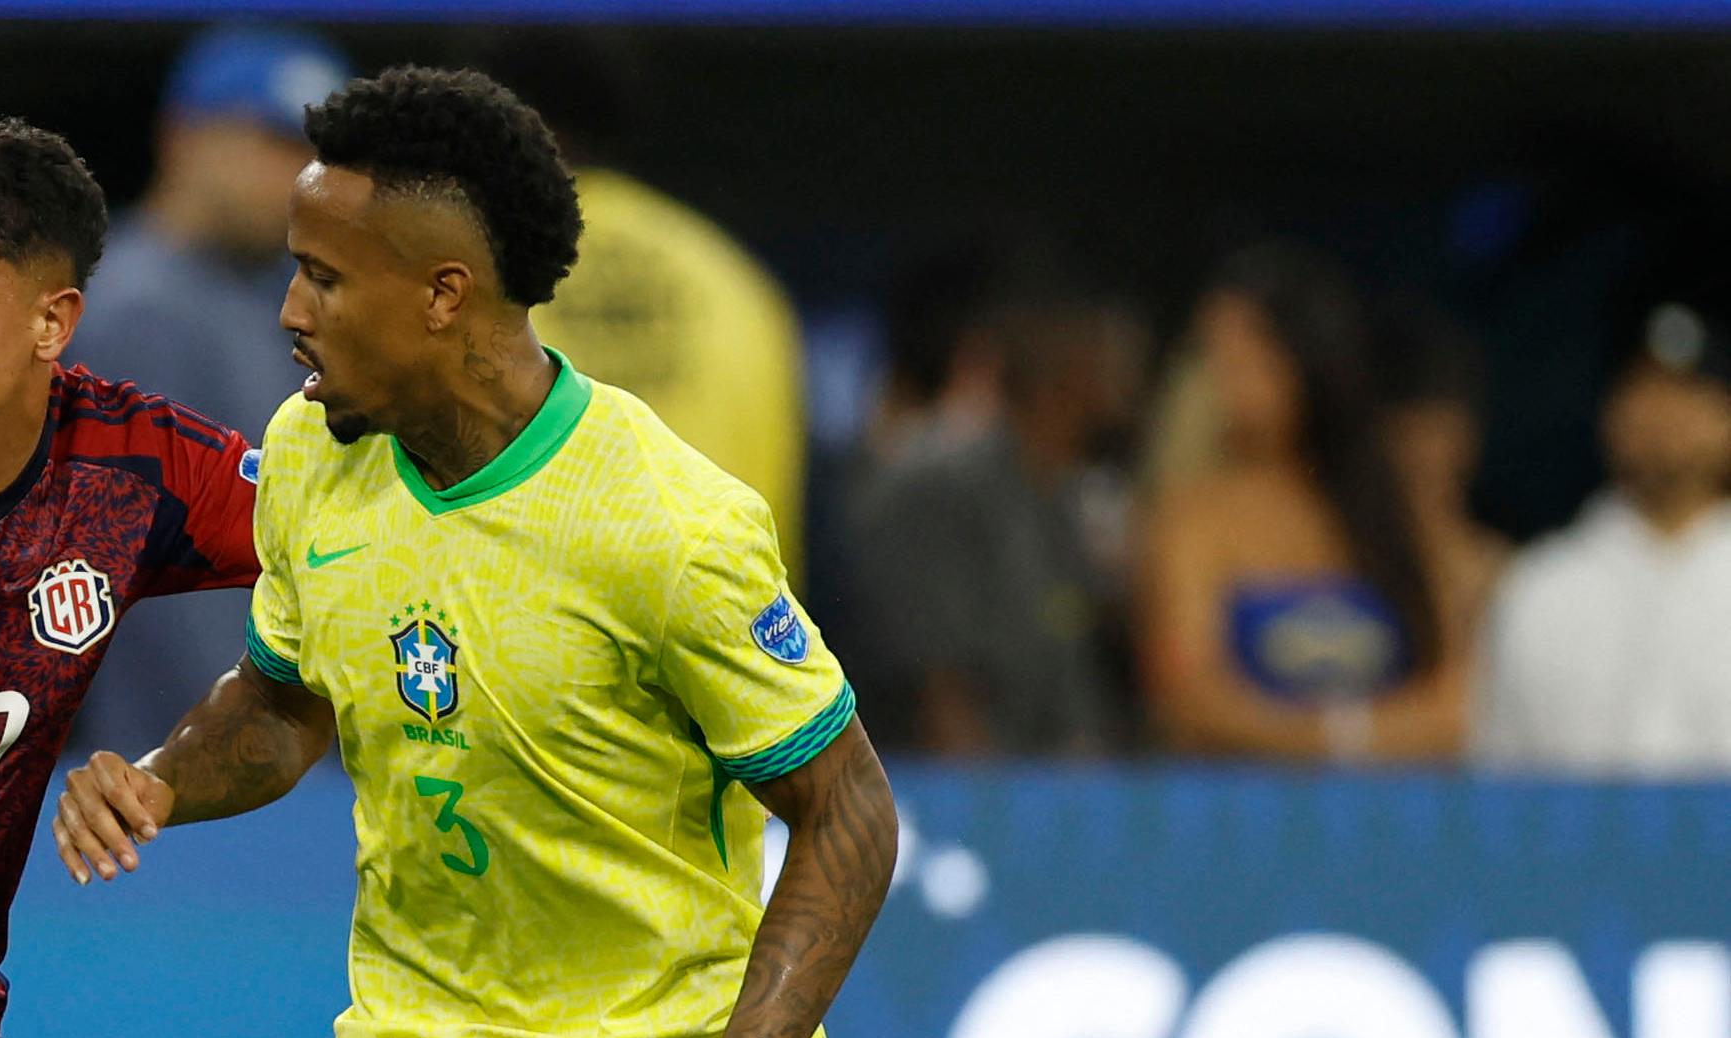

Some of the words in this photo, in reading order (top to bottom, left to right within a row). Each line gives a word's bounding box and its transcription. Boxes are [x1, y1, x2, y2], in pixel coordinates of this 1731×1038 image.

[46, 579, 95, 635] CR
[414, 661, 439, 675] CBF
[402, 723, 472, 750] BRASIL
[414, 775, 489, 877] 3
